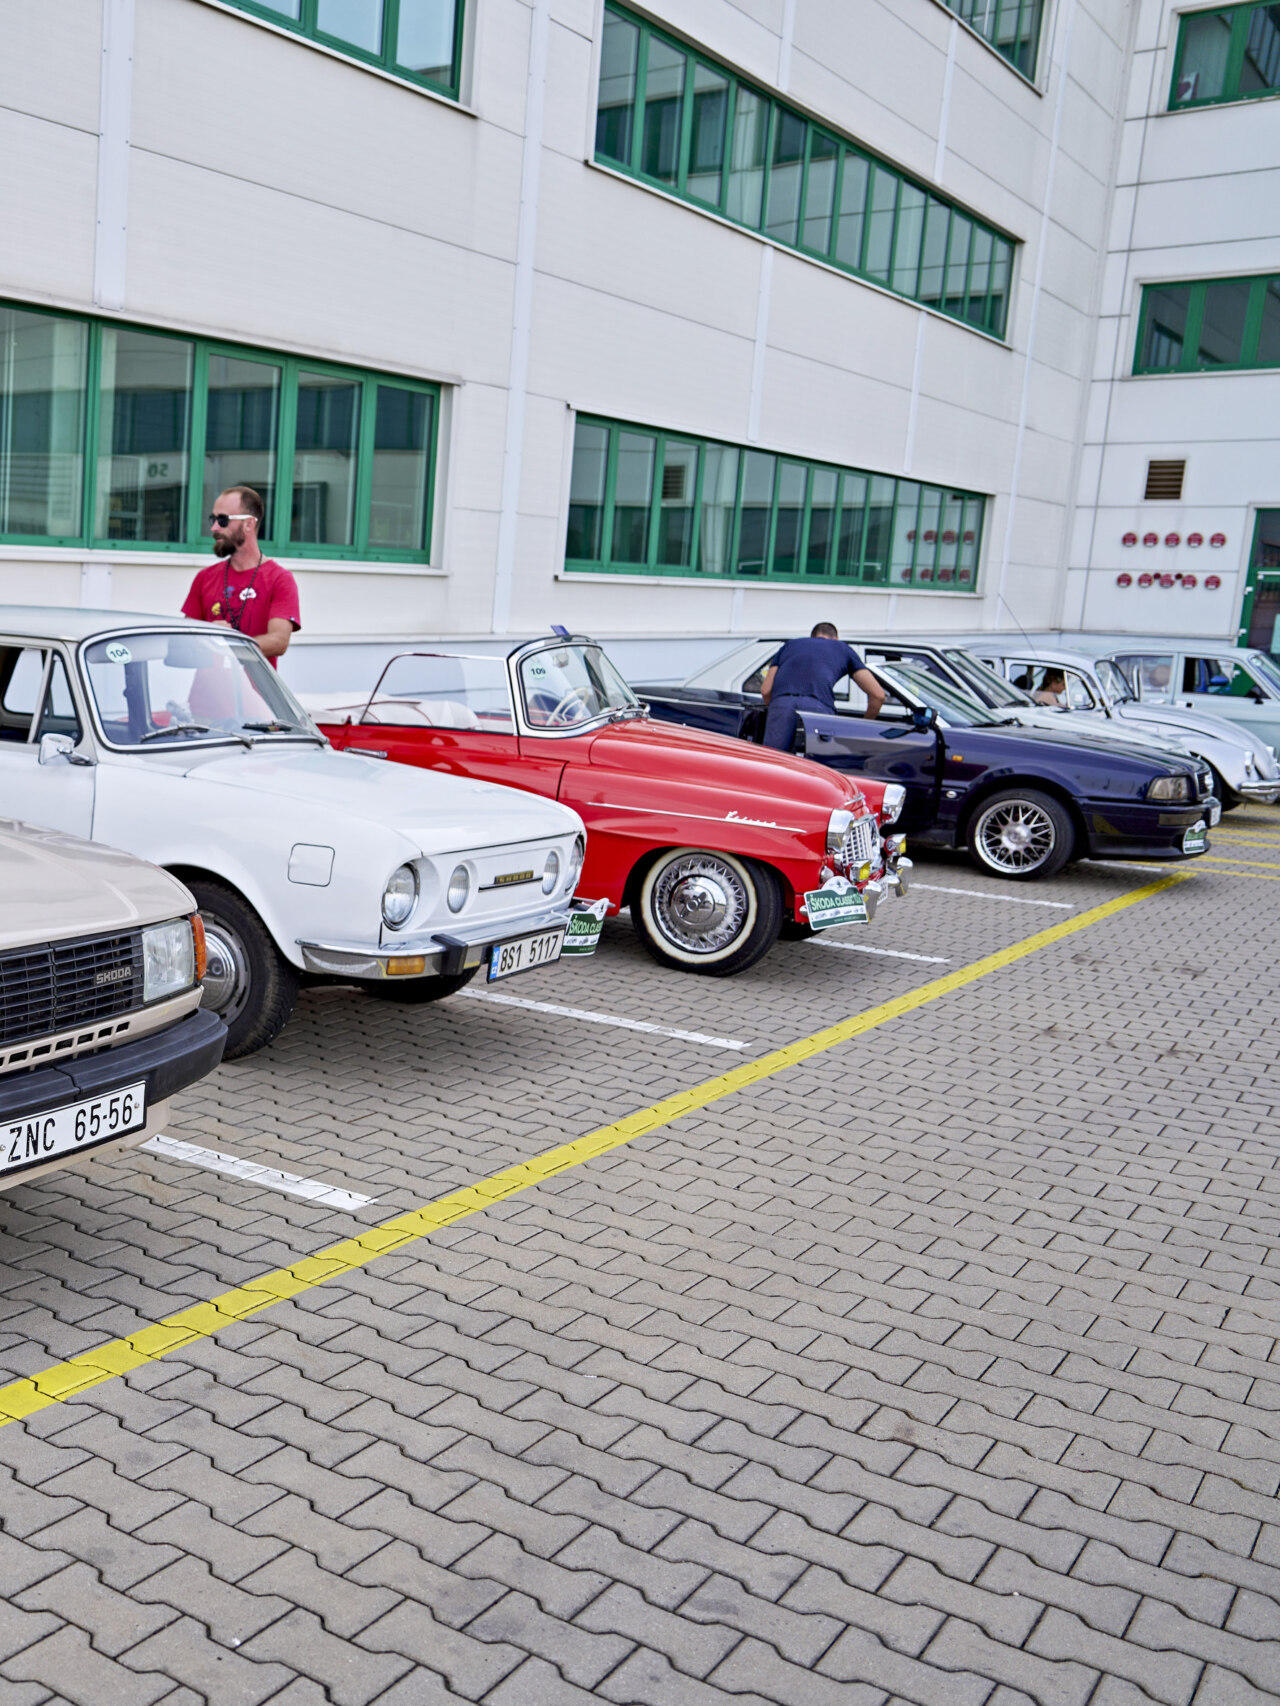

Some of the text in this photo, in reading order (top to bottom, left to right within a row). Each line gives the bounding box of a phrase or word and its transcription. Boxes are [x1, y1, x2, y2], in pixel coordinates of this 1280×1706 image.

[109, 648, 129, 658] 104
[499, 934, 559, 972] 8S1 5117
[7, 1093, 133, 1163] ZNC 65-56
